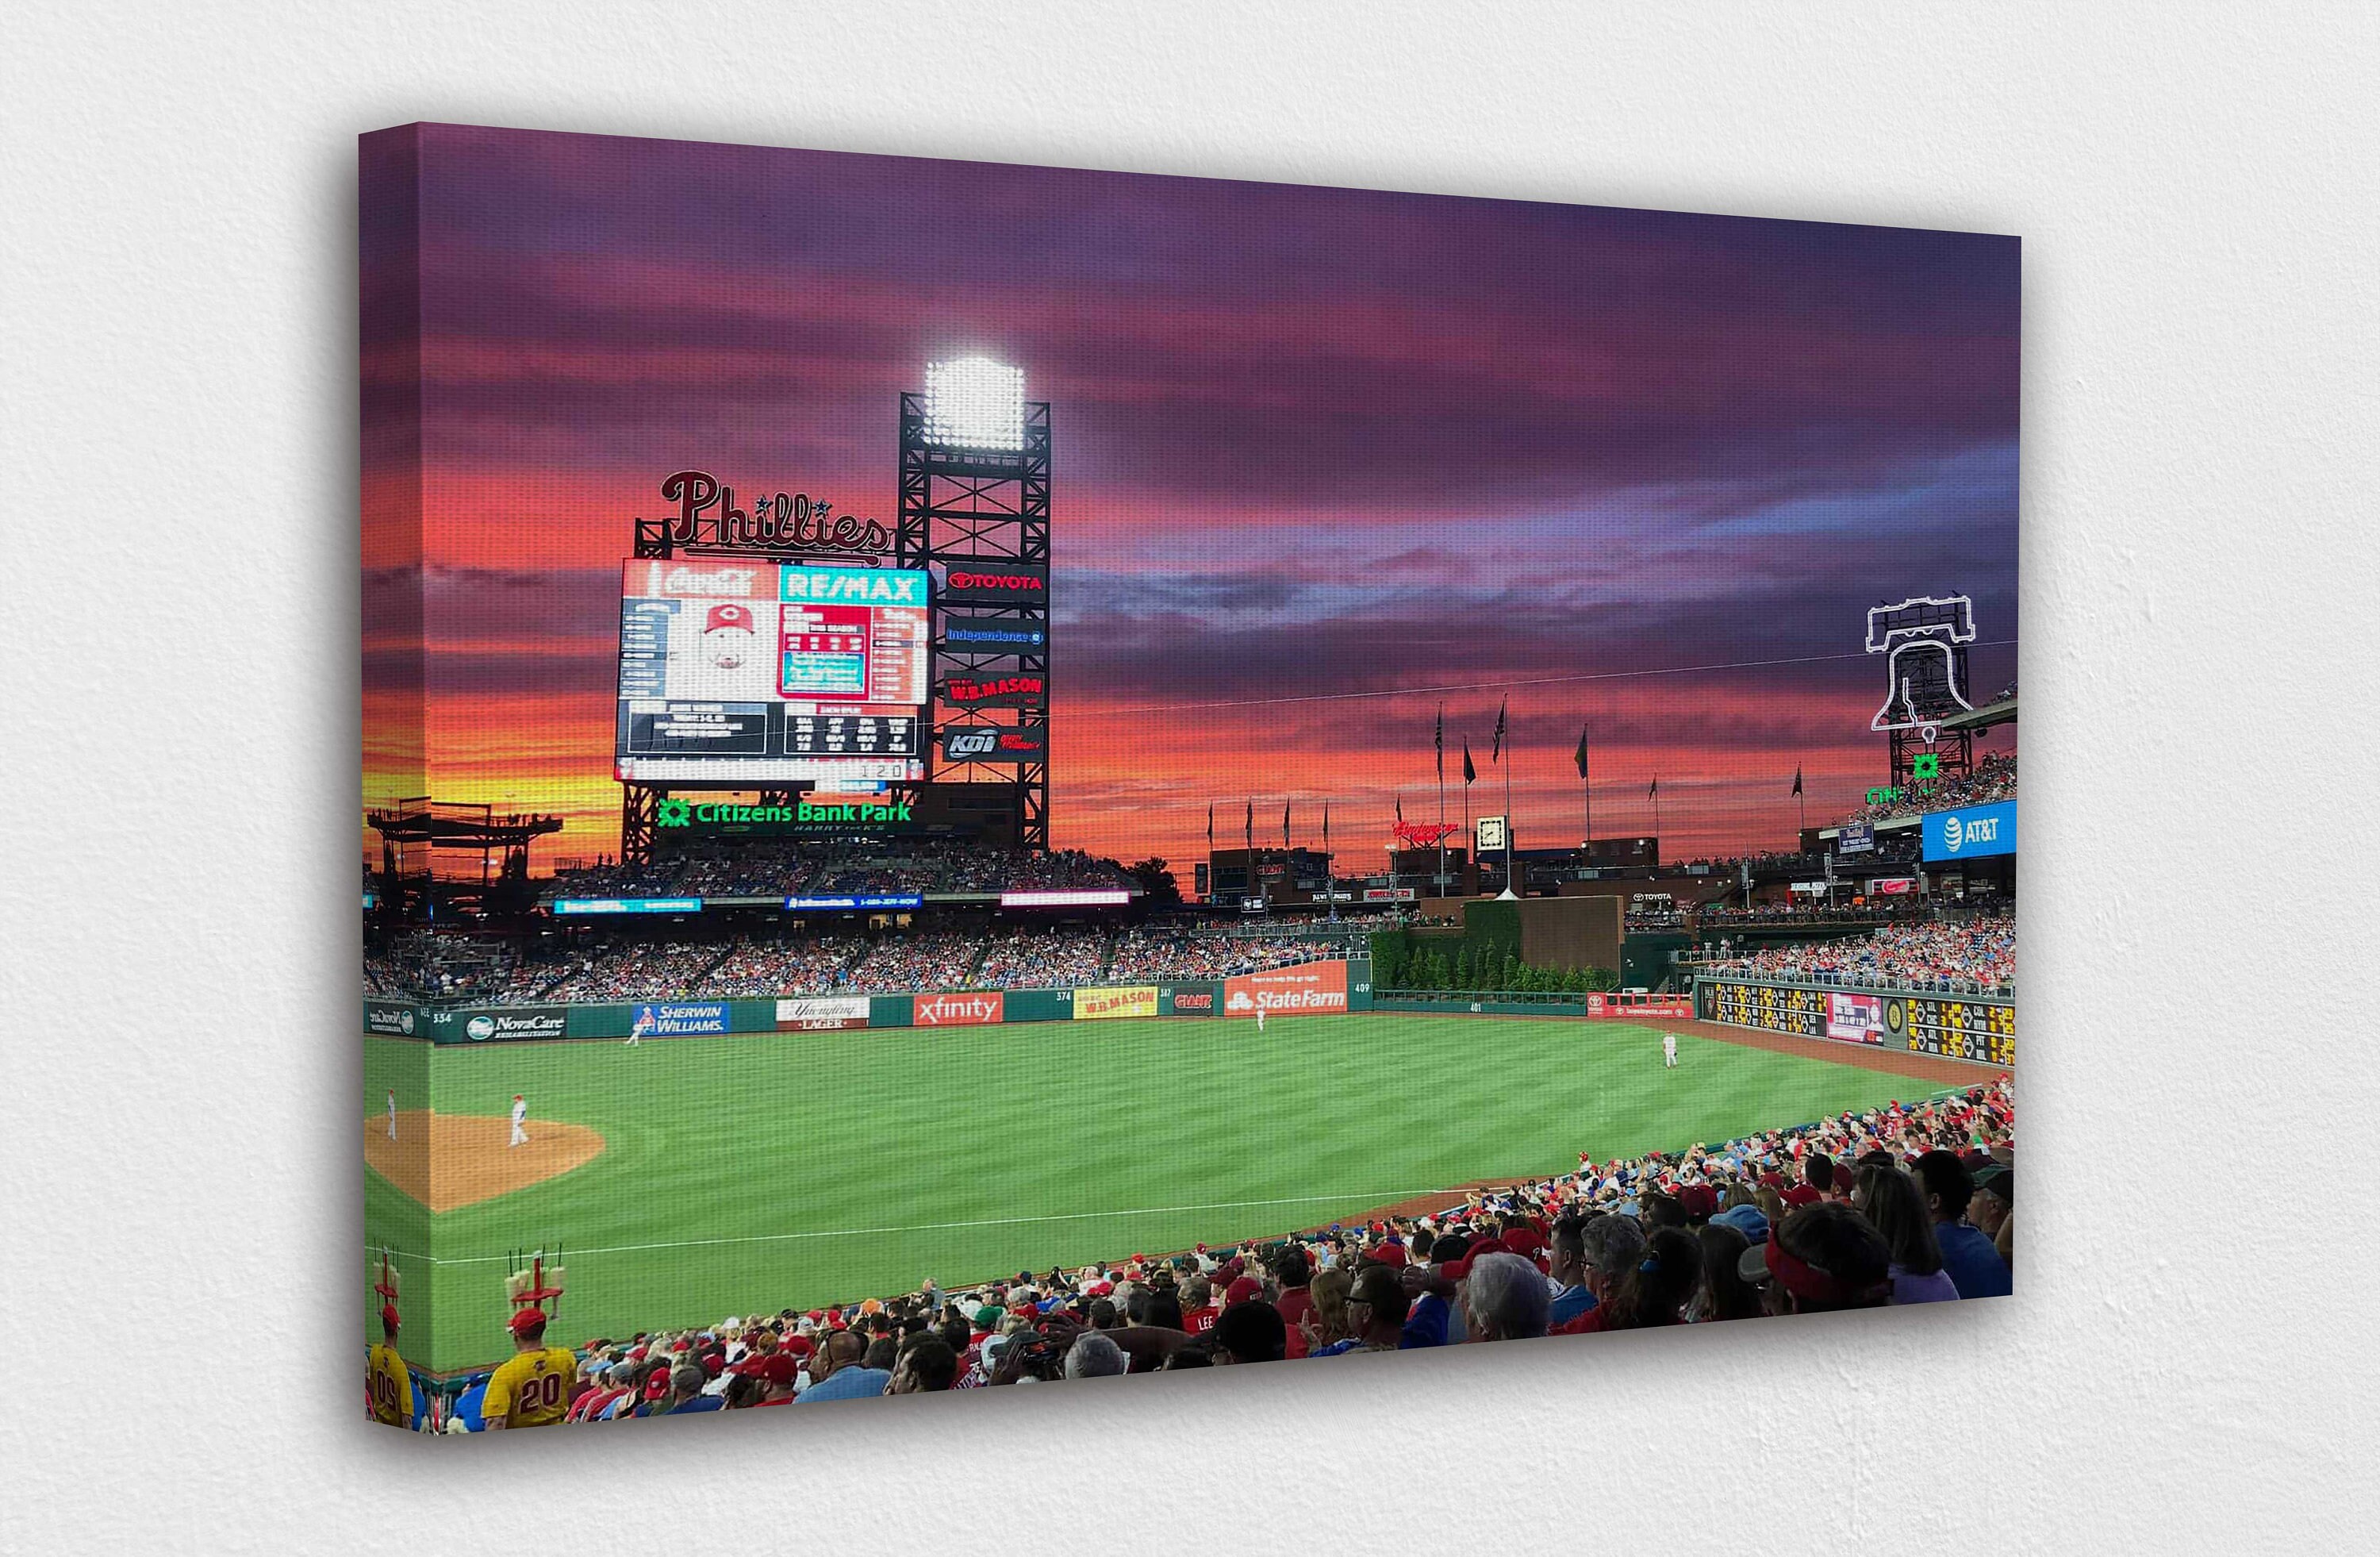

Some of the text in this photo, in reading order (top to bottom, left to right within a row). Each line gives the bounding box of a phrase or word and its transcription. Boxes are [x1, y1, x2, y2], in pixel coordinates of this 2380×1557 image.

[662, 471, 890, 551] Phillies
[786, 574, 918, 601] RE/MAX
[973, 575, 1042, 590] TOYOTA
[946, 629, 1030, 644] Independence
[949, 735, 996, 752] KDI
[697, 802, 912, 822] Citizens Bank Park
[1964, 817, 1999, 844] AT&T
[1355, 983, 1370, 993] 409
[1175, 994, 1212, 1009] GIANT
[1926, 1001, 1937, 1013] STL
[658, 1005, 722, 1019] SHERWIN
[793, 1001, 854, 1018] Yuengling
[919, 997, 999, 1024] xfinity
[1973, 1005, 1985, 1017] COL
[494, 1015, 565, 1030] NovaCare
[802, 1020, 843, 1029] LAGER
[1197, 1315, 1214, 1331] LEE
[519, 1372, 561, 1414] 20
